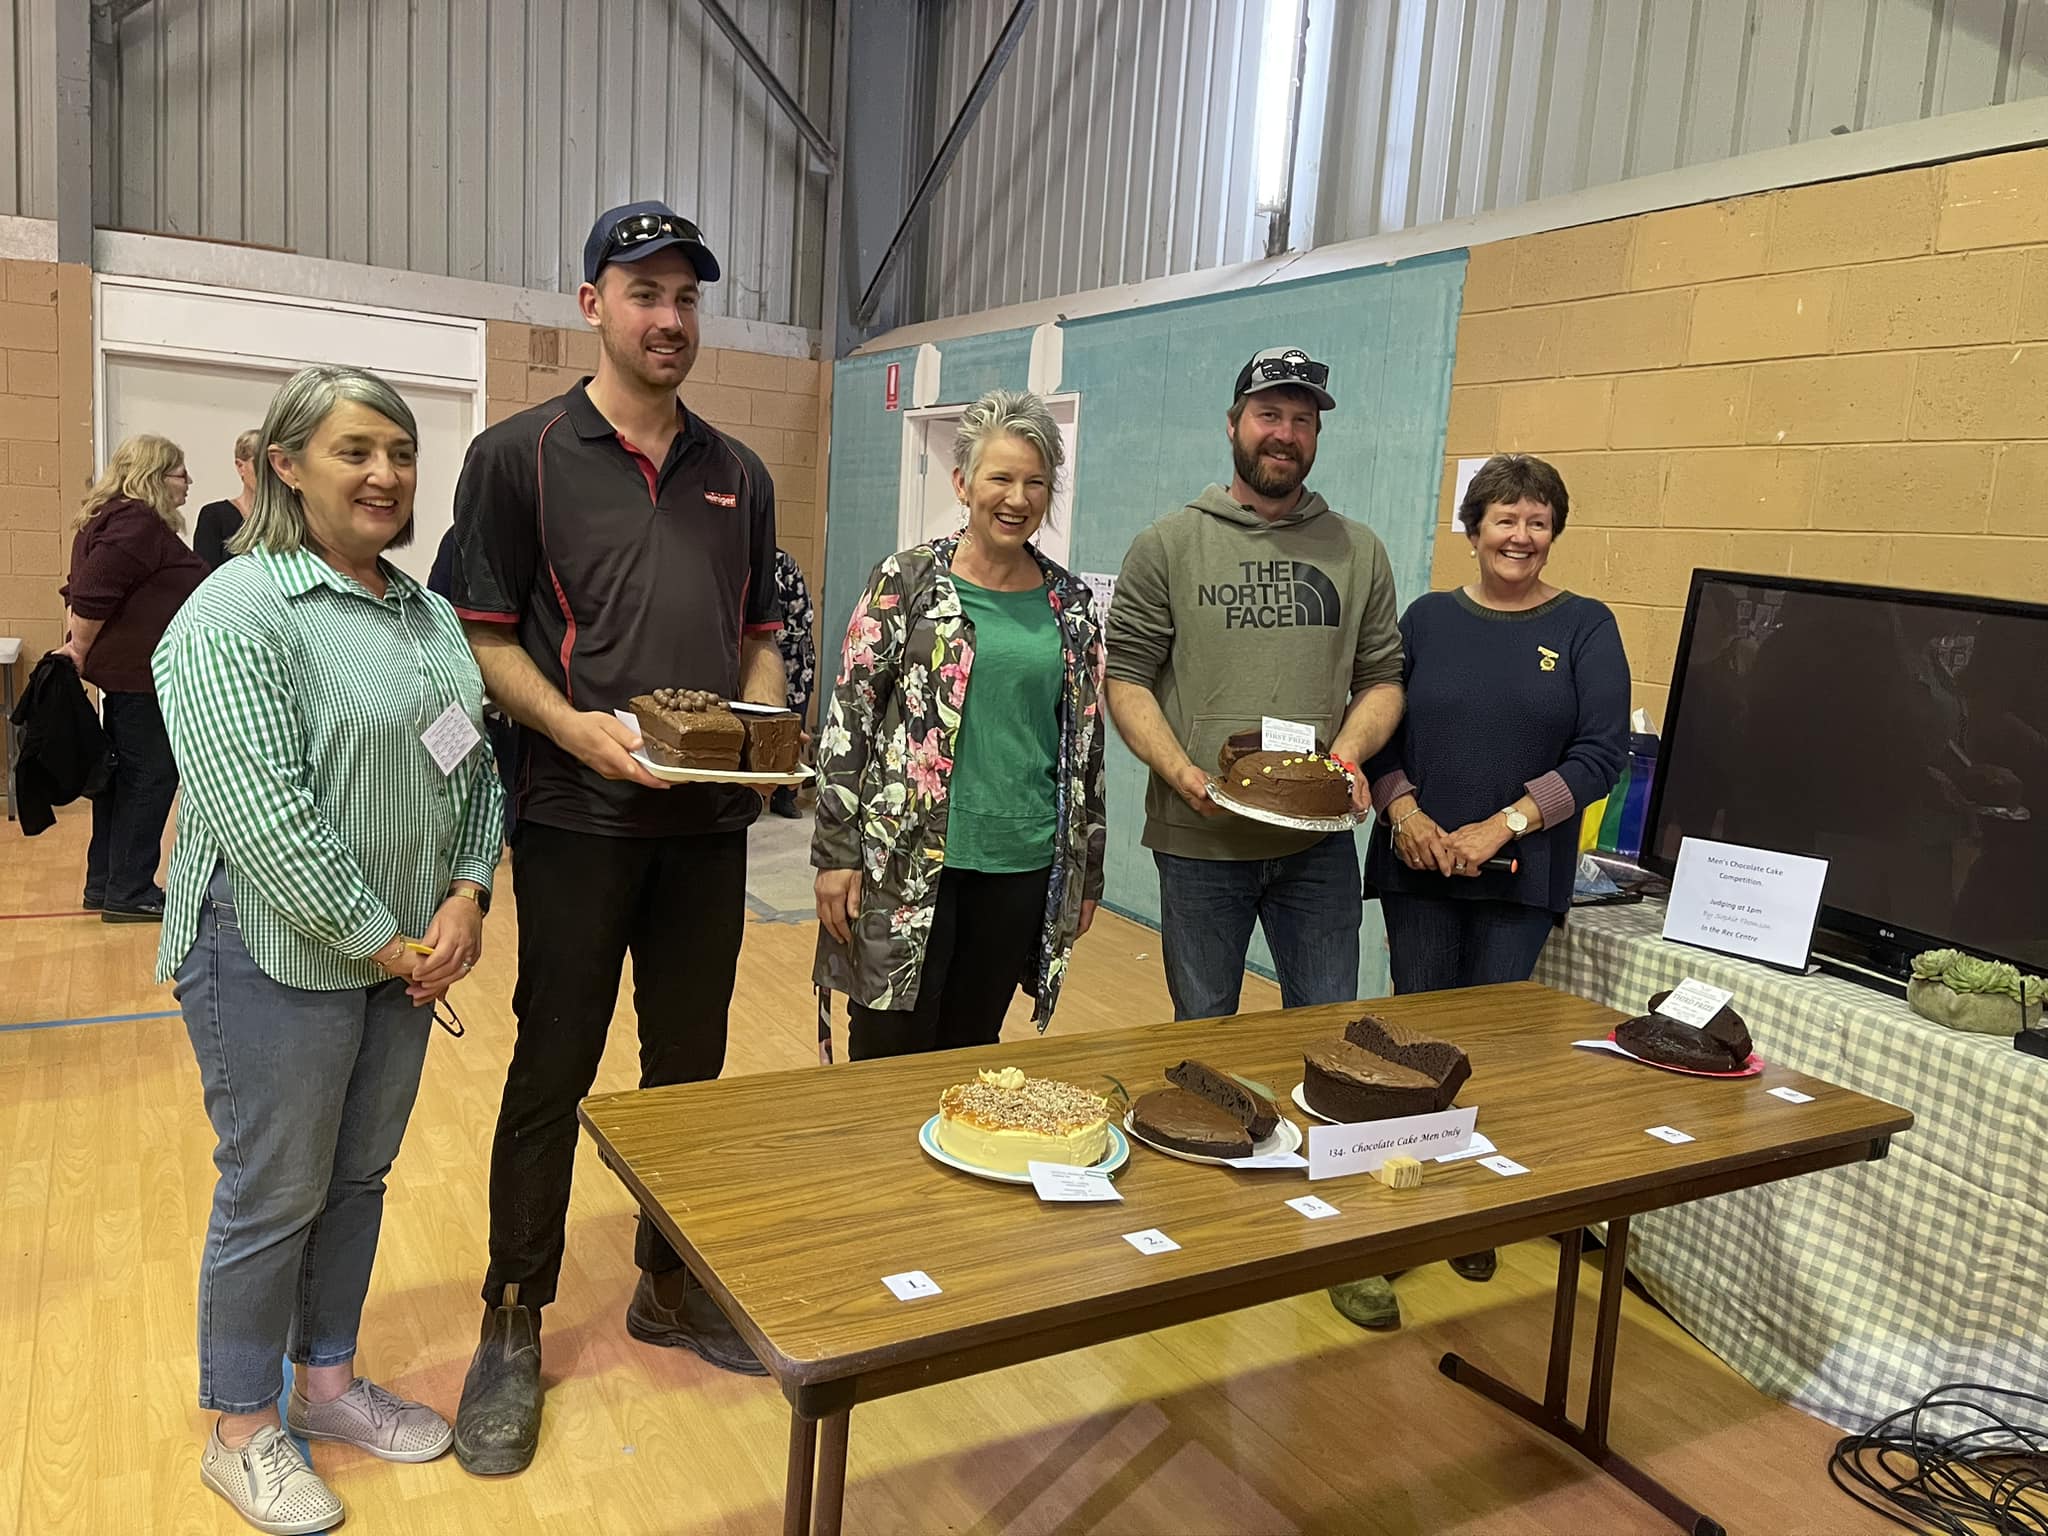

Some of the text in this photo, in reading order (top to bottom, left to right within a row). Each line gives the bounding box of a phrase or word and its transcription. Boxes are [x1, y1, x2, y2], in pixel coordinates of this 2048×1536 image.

[1239, 561, 1290, 583] THE
[1198, 583, 1293, 606] NORTH
[1226, 605, 1293, 629] FACE
[1707, 857, 1784, 876] Men's Chocolate Cake
[1710, 899, 1736, 911] Judging
[1746, 906, 1763, 914] 1pm
[1709, 926, 1720, 934] the
[1735, 932, 1758, 942] Centre
[1351, 1139, 1395, 1153] Chocolate
[1397, 1134, 1418, 1146] Cake
[1420, 1132, 1440, 1142] Men
[1441, 1126, 1461, 1138] Only
